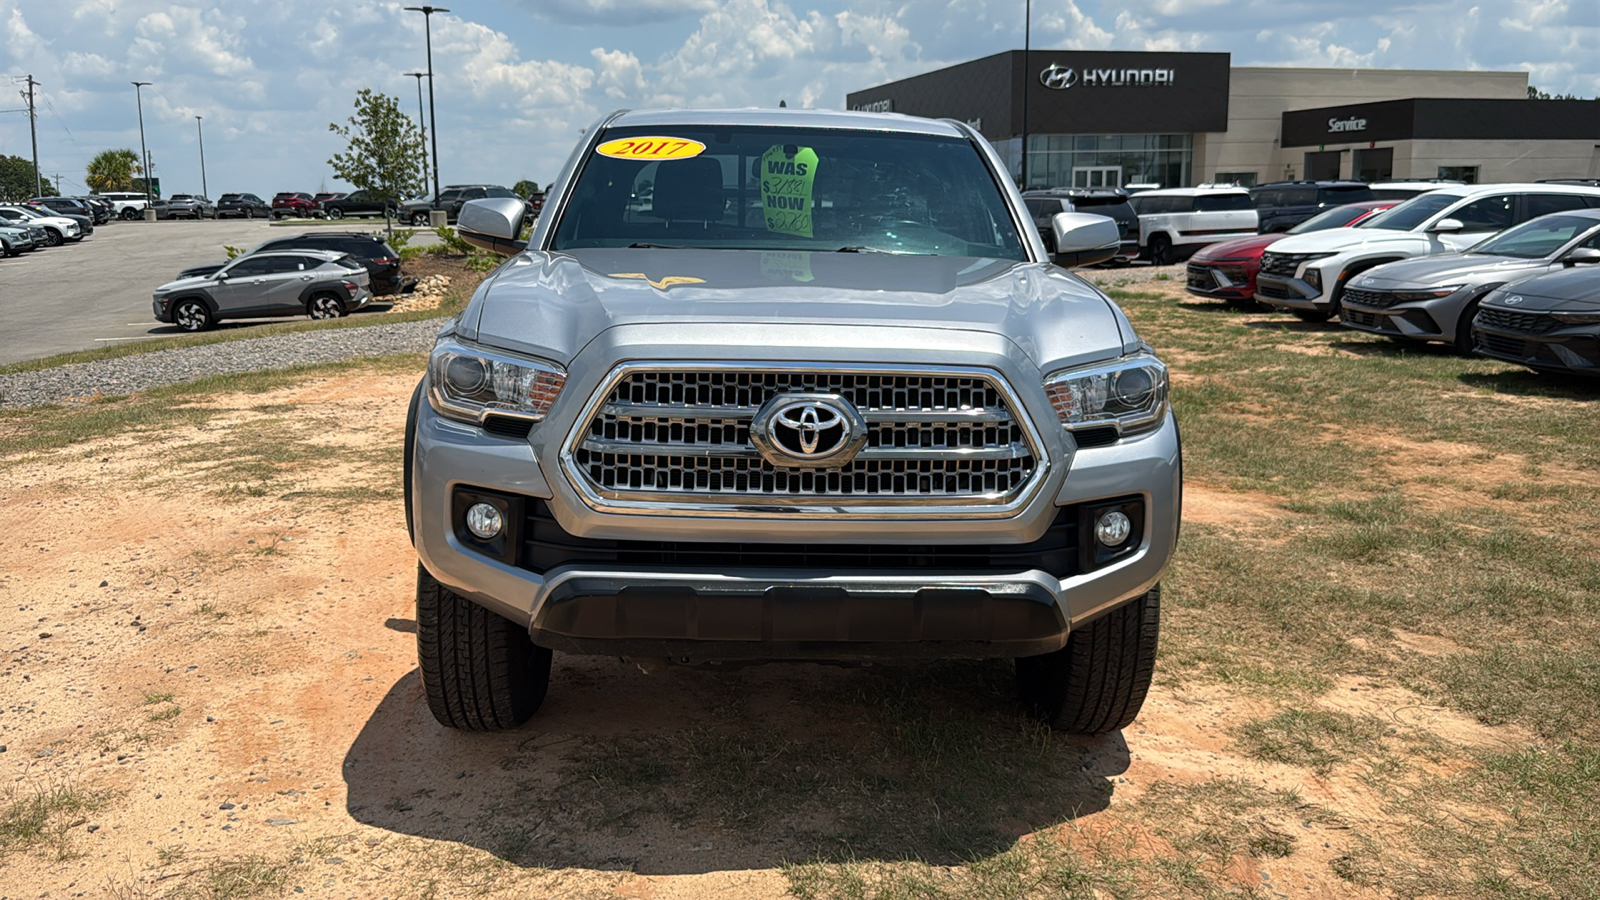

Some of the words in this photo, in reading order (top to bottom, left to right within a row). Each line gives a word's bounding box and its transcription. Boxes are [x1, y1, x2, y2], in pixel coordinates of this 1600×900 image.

[1083, 68, 1174, 83] HYUNDAI
[1328, 116, 1367, 133] Service
[612, 141, 690, 155] 2017
[768, 161, 808, 176] WAS
[767, 195, 804, 210] NOW
